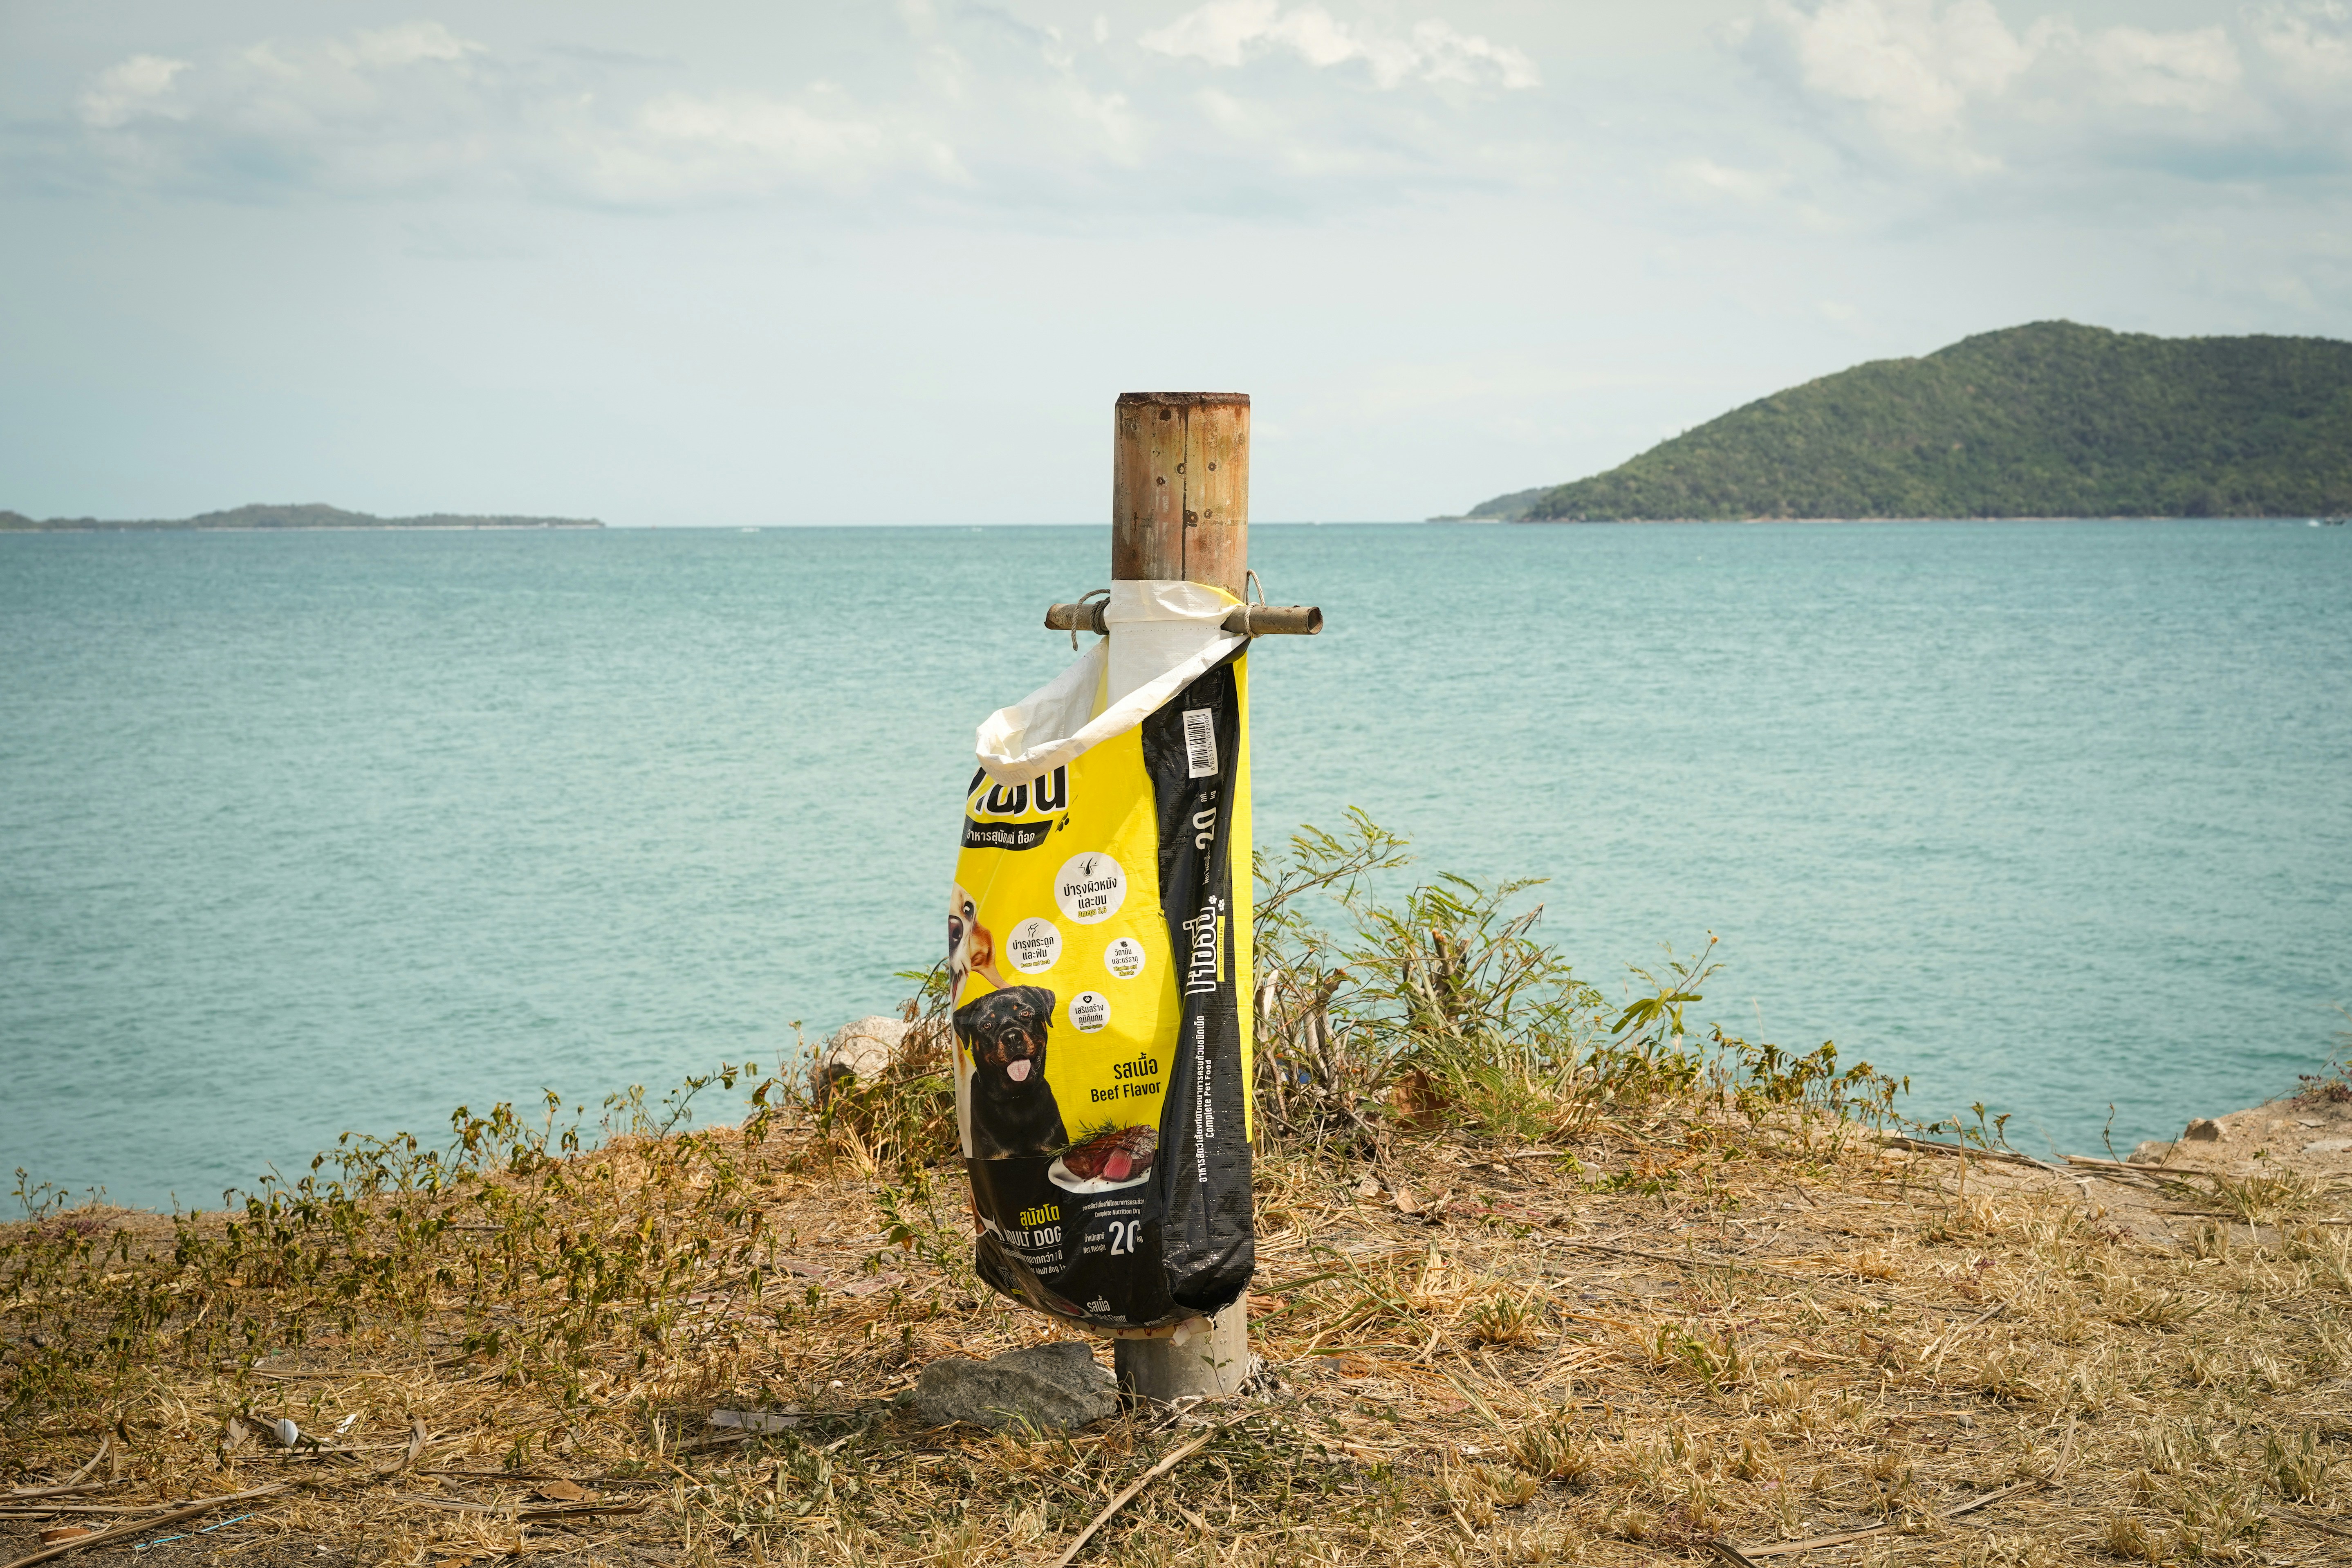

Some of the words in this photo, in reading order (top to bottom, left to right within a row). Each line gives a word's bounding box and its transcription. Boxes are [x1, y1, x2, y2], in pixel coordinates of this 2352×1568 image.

[1210, 790, 1217, 800] kg
[1193, 807, 1217, 850] 20
[1018, 830, 1035, 844] ด็อก
[1064, 877, 1117, 897] บำรุงผิวหนัง
[1078, 895, 1107, 908] และขน
[1078, 909, 1096, 917] Omega
[1013, 937, 1054, 951] บำรุงกระดูก
[1022, 948, 1047, 960] และฟัน
[1114, 948, 1132, 956] วิตามิน
[1112, 955, 1139, 964] และแร่ธาตุ
[1075, 1003, 1103, 1014] เสริมสร้าง
[1078, 1013, 1103, 1025] ภูมิคุ้มกัน
[1113, 1052, 1158, 1079] รสเนื้อ
[1091, 1085, 1119, 1102] Beef
[1123, 1082, 1161, 1098] Flavor
[1204, 1099, 1215, 1138] Complete
[1020, 1203, 1060, 1230] สุนัขโต
[1003, 1228, 1030, 1247] ADULT
[1034, 1226, 1061, 1247] DOG
[1136, 1235, 1143, 1243] kg
[1058, 1249, 1063, 1260] ปี
[1090, 1244, 1106, 1252] Weight
[1087, 1295, 1111, 1312] รสเนื้อ
